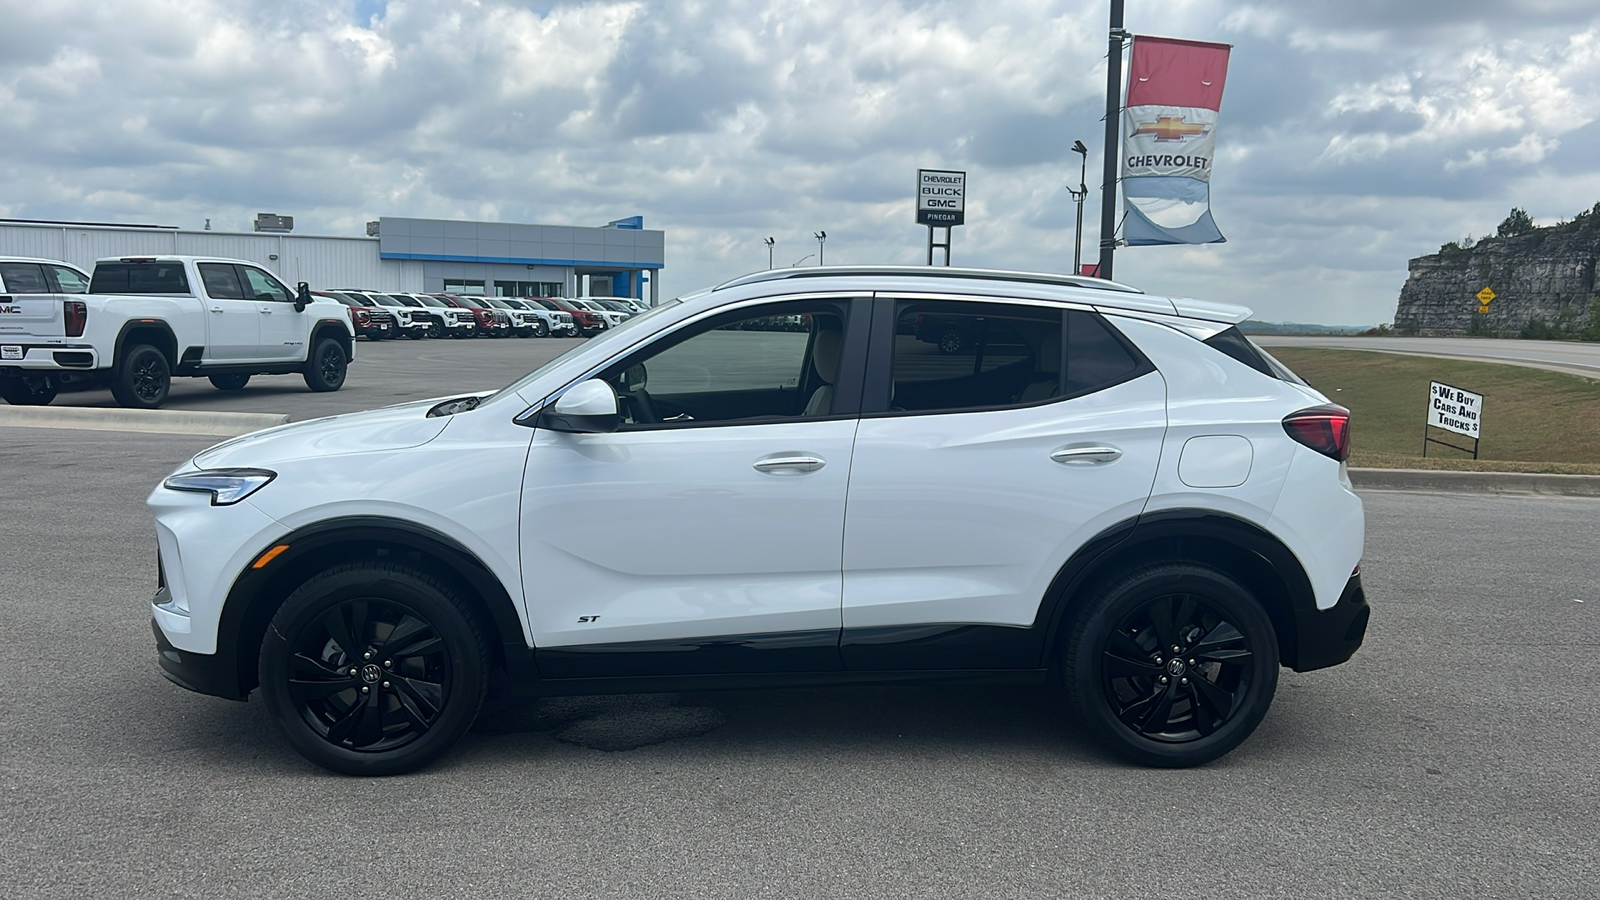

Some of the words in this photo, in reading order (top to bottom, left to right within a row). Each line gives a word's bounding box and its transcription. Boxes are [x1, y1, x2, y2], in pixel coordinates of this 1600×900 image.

[1128, 154, 1208, 170] CHEVROLET
[923, 175, 962, 184] CHEVROLET
[922, 187, 962, 196] BUICK
[927, 199, 957, 208] GMC
[927, 213, 956, 221] PINEGAR
[577, 615, 601, 623] ST
